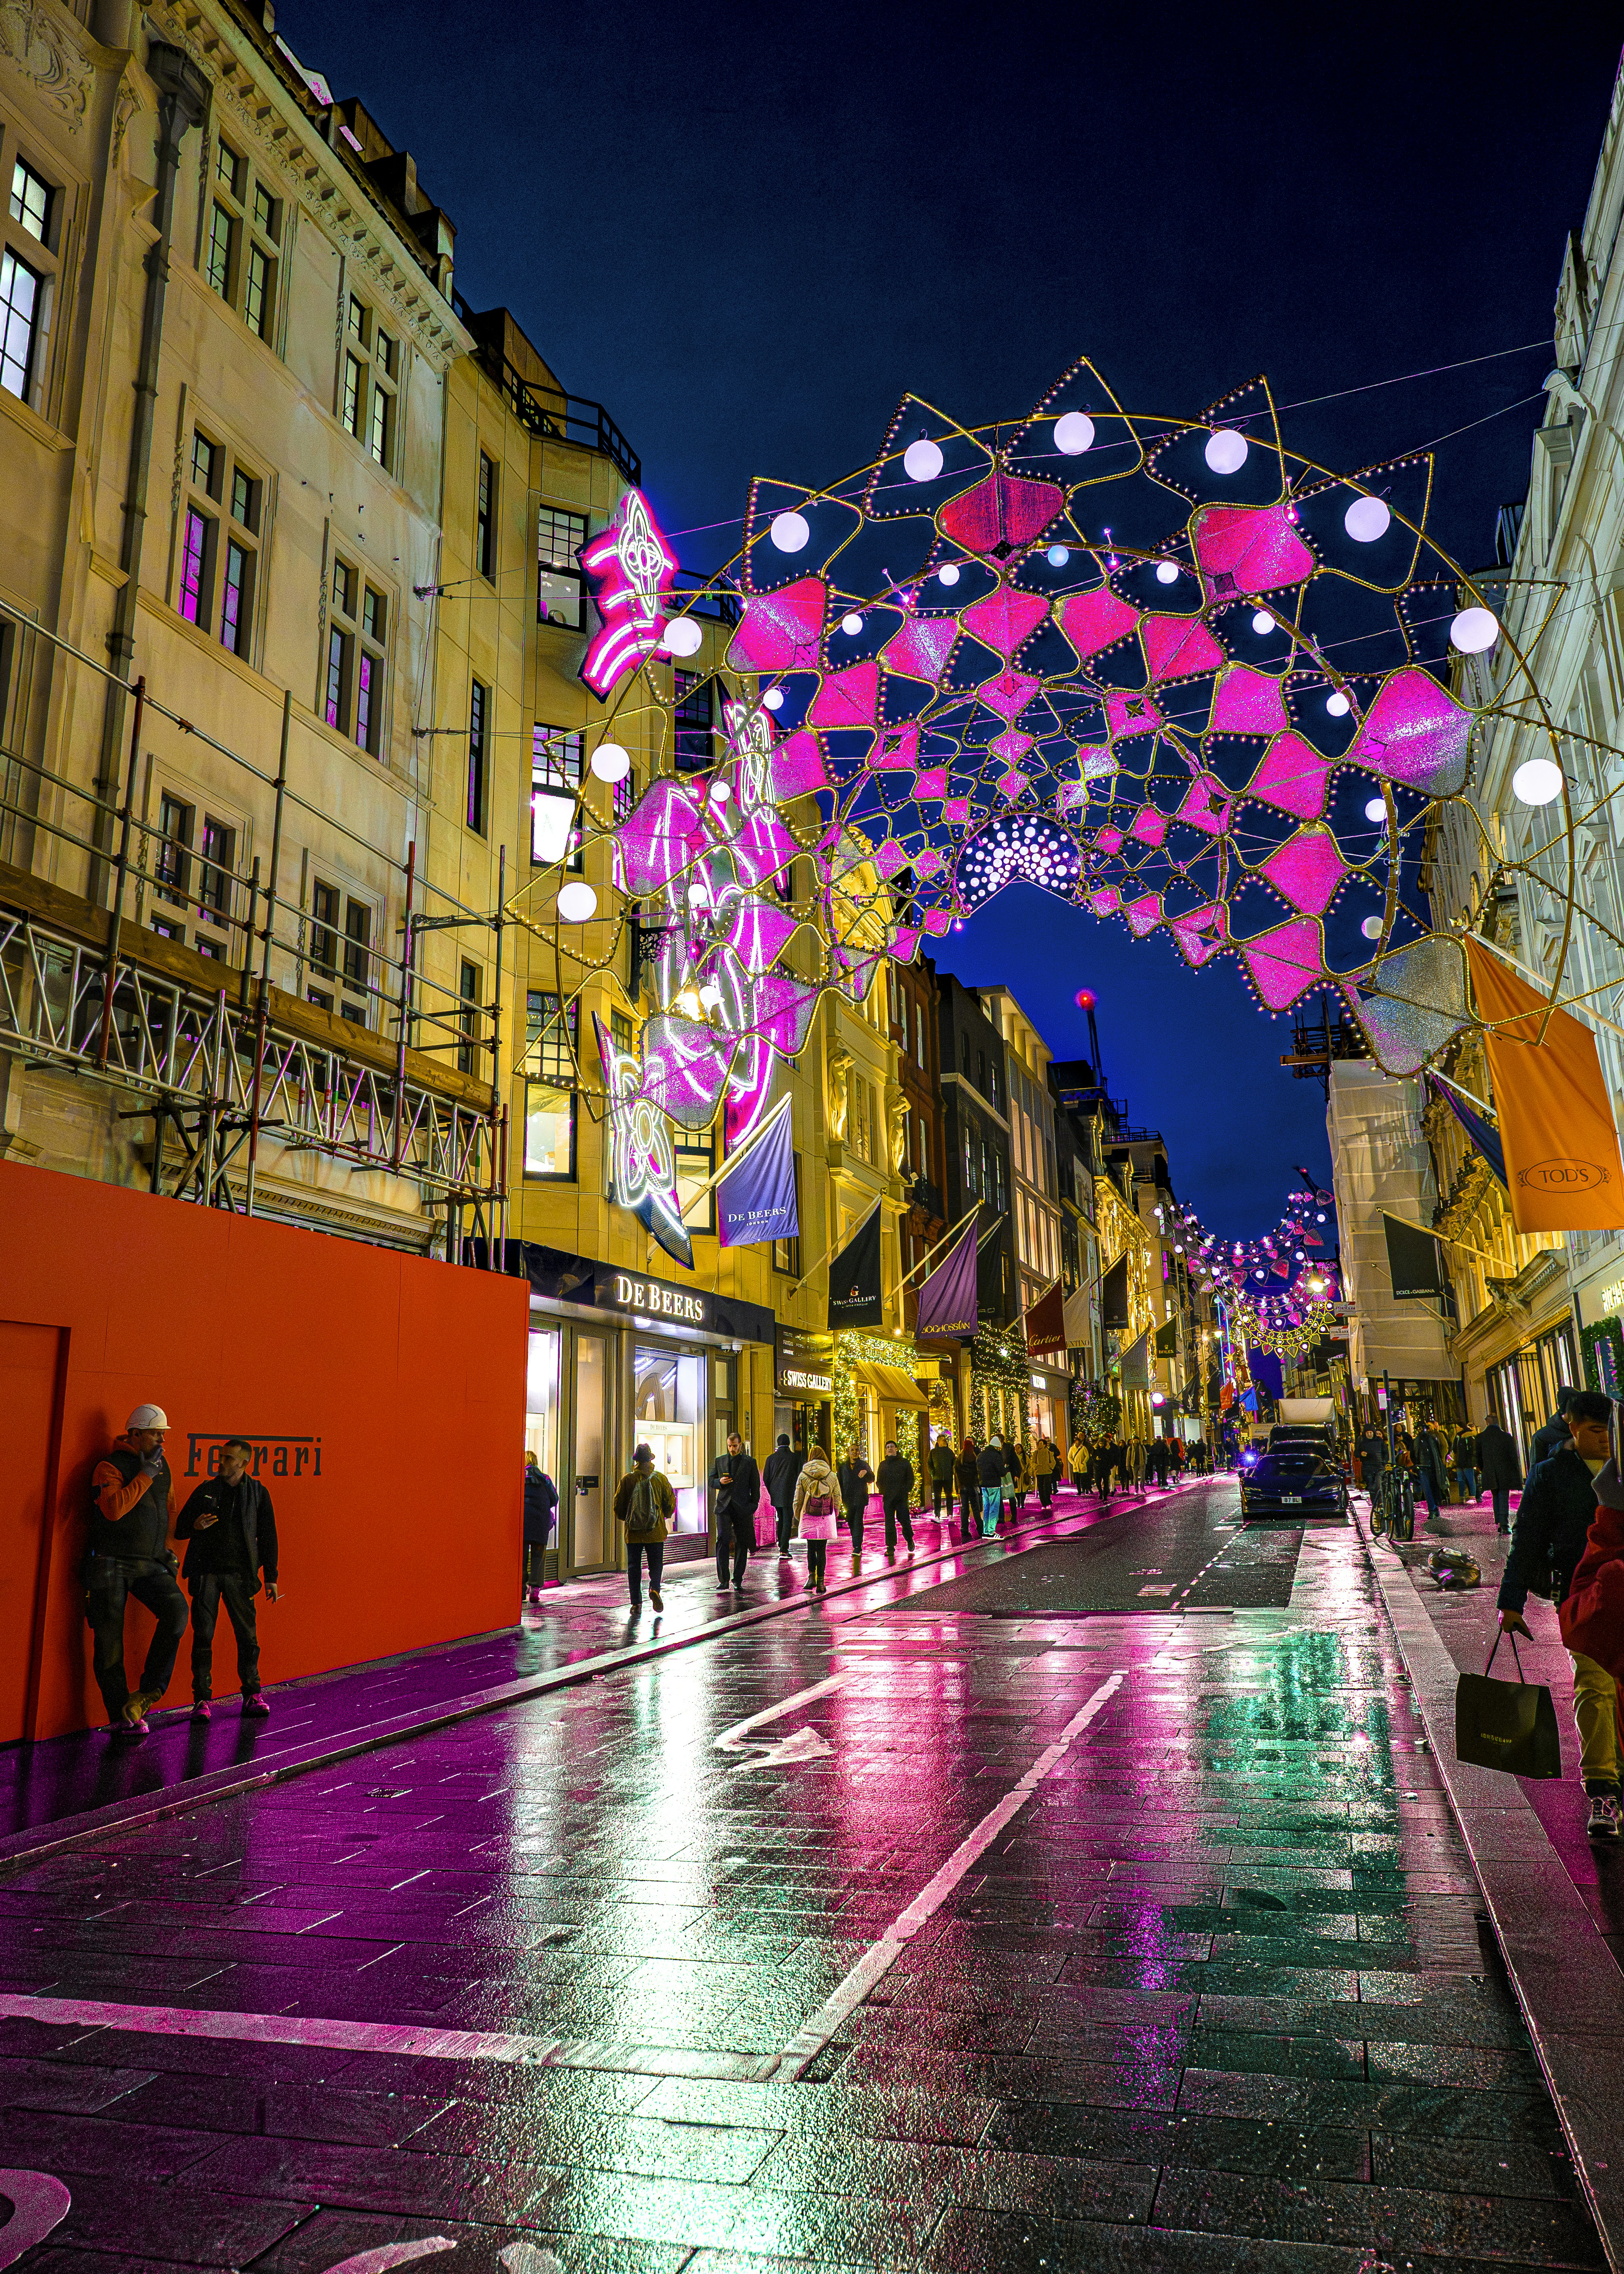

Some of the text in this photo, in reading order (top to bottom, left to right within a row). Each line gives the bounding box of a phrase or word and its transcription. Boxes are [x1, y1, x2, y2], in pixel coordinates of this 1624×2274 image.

[1538, 1169, 1589, 1183] TOD'S
[728, 1206, 786, 1223] DE BEERS
[617, 1275, 703, 1321] DE BEERS
[849, 1295, 876, 1303] GALLERY
[1029, 1334, 1063, 1346] Cartier
[787, 1370, 832, 1391] SWISS GALLERY
[183, 1433, 321, 1477] Ferari
